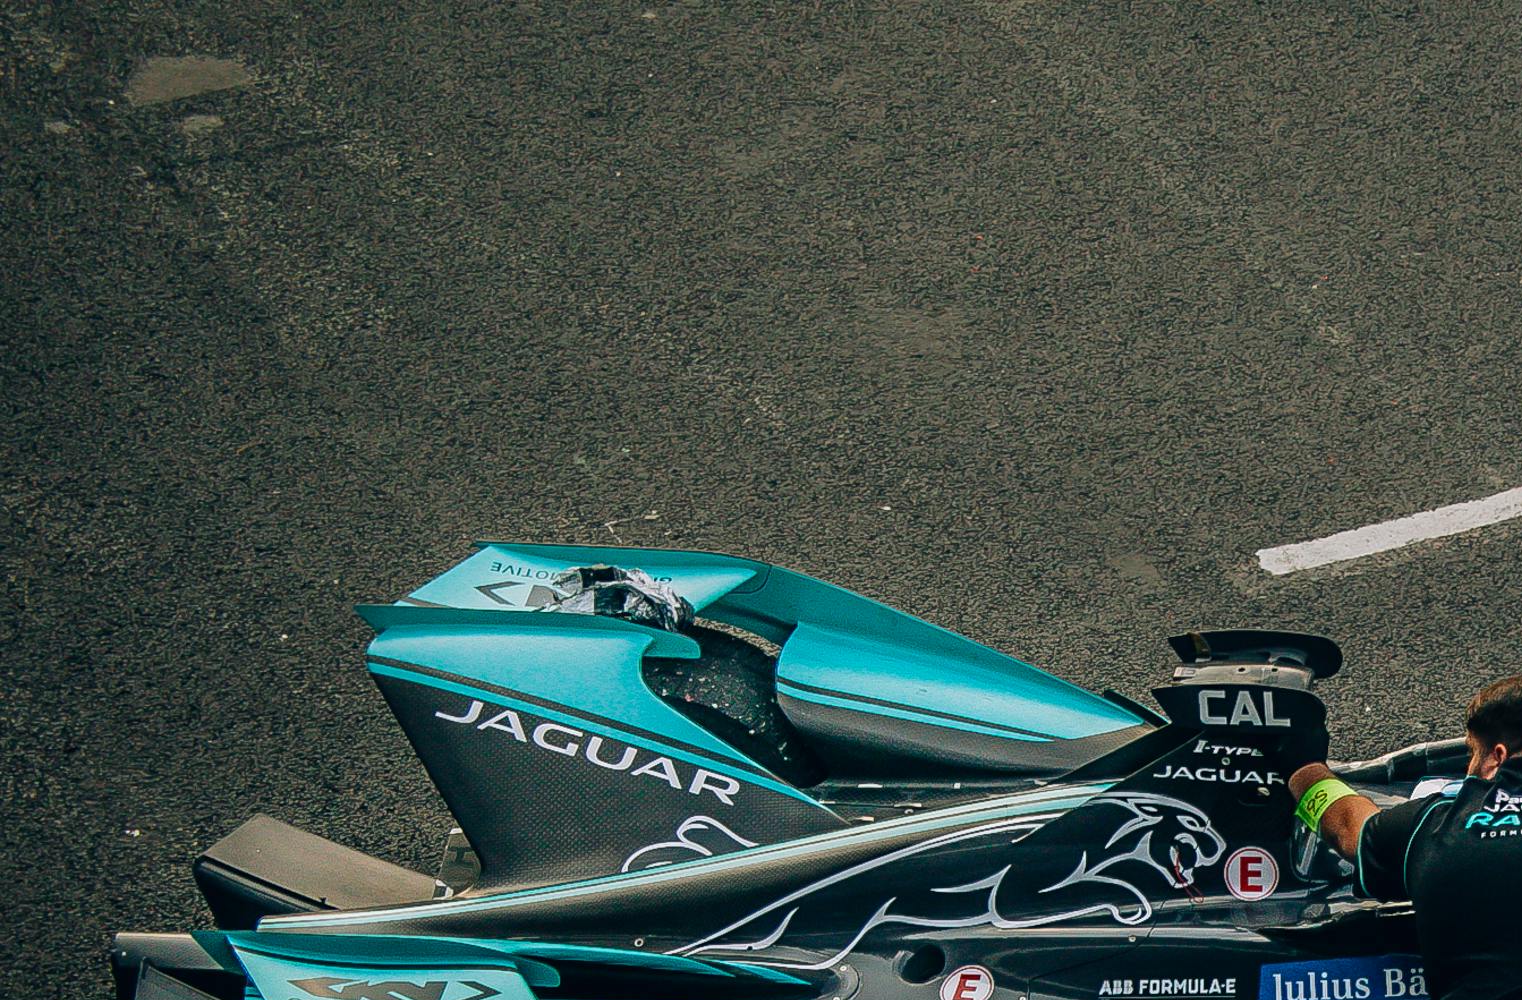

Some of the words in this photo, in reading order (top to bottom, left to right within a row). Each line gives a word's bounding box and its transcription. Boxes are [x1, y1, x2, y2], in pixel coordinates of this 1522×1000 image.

[1198, 690, 1291, 727] CAL
[435, 701, 741, 805] JAGUAR
[1239, 857, 1263, 892] E
[1099, 979, 1133, 995] ABB
[1383, 967, 1428, 998] Bä
